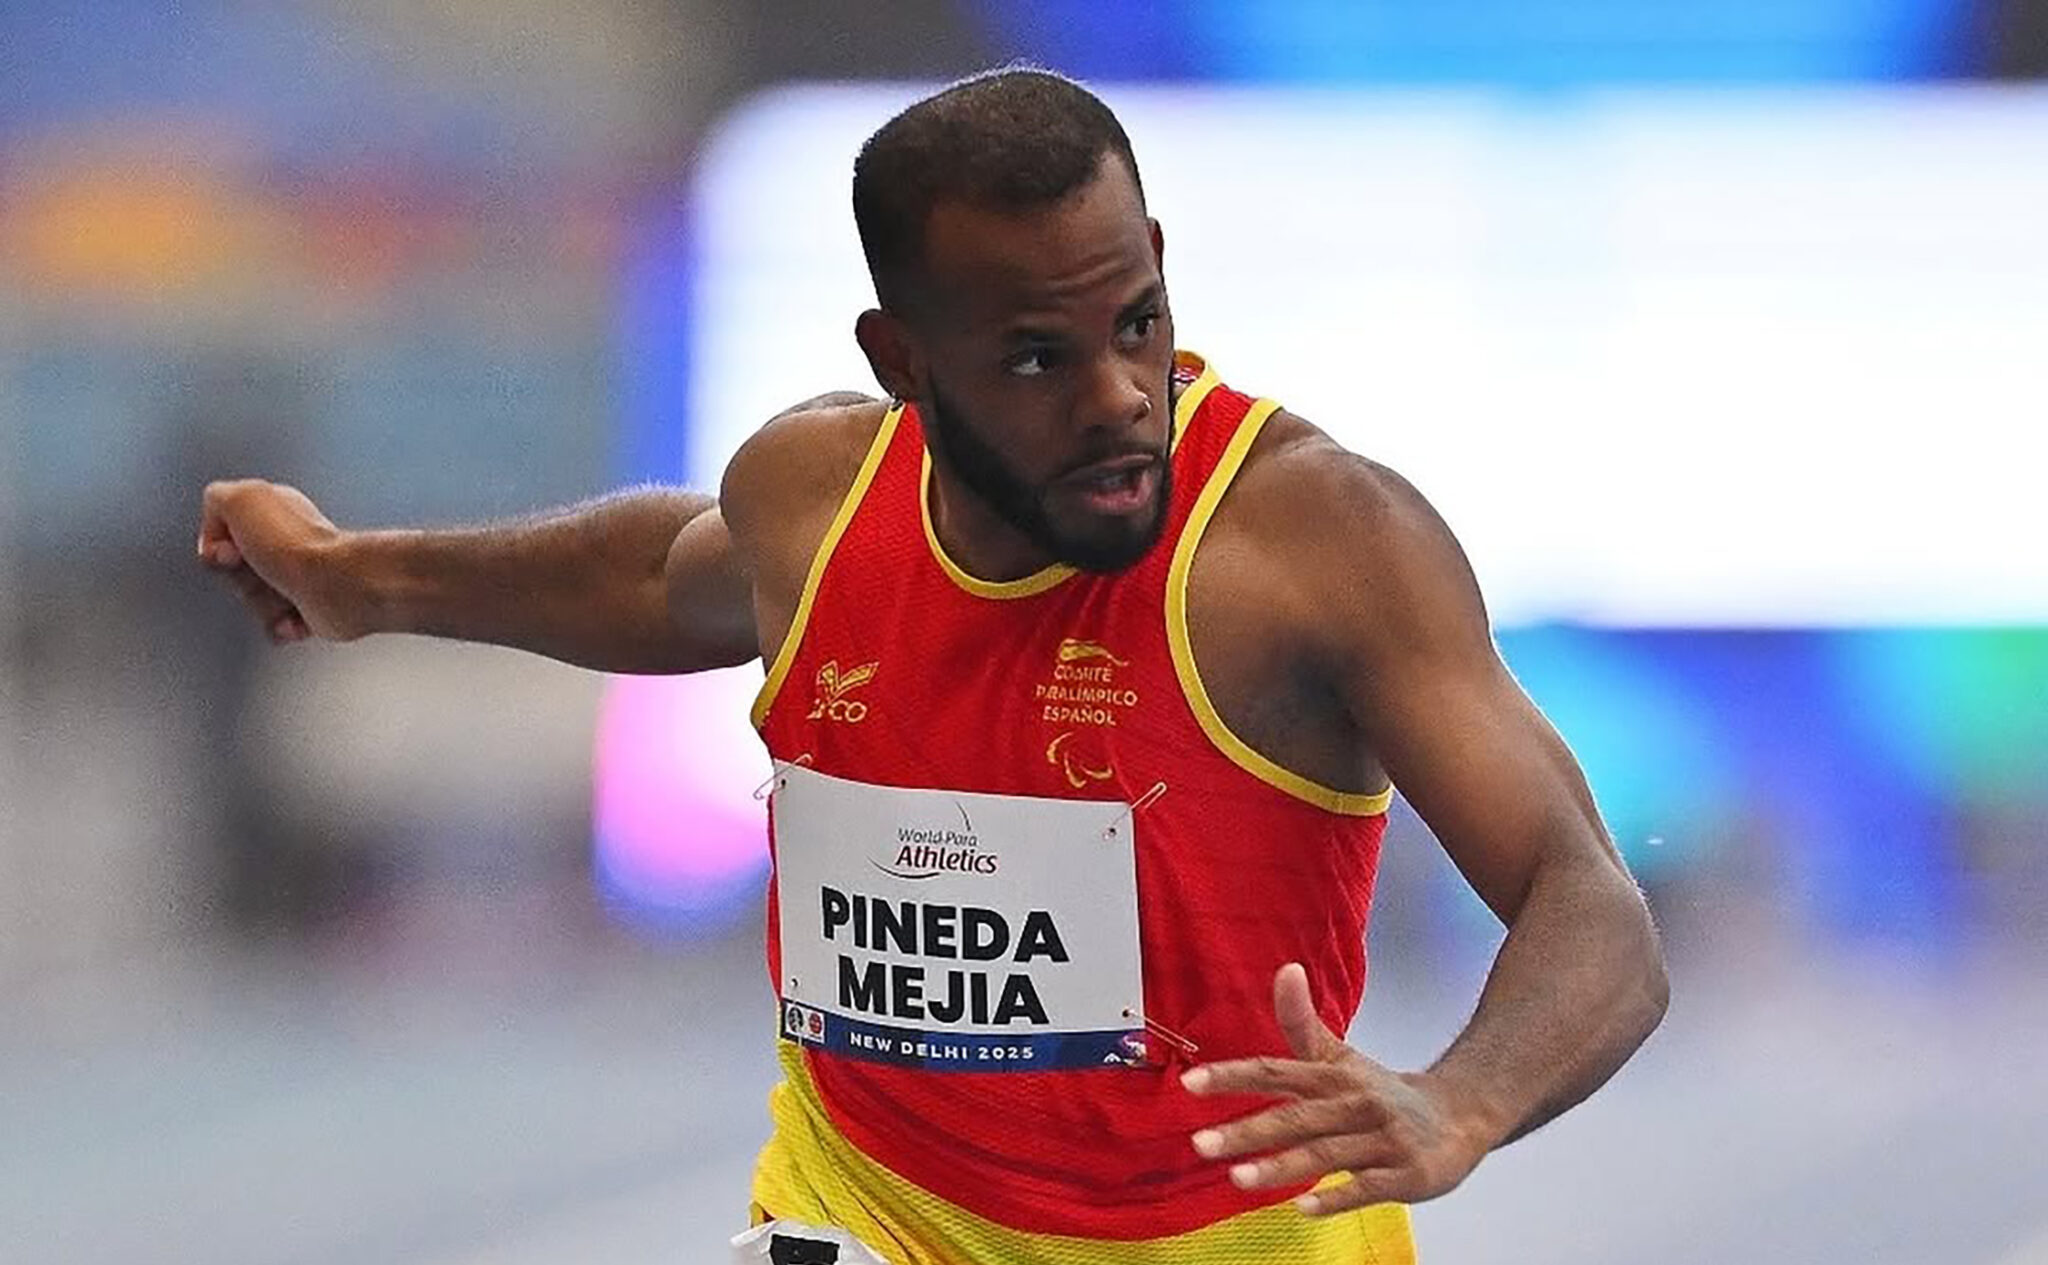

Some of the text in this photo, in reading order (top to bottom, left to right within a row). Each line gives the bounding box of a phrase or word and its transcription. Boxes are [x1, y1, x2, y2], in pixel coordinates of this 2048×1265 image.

[1042, 704, 1117, 726] ESPAÑOL
[898, 828, 978, 846] World Para
[895, 845, 998, 874] Athletics
[821, 886, 1070, 963] PINEDA
[837, 955, 1050, 1026] MEJIA
[849, 1032, 1034, 1060] NEW DELHI 2025
